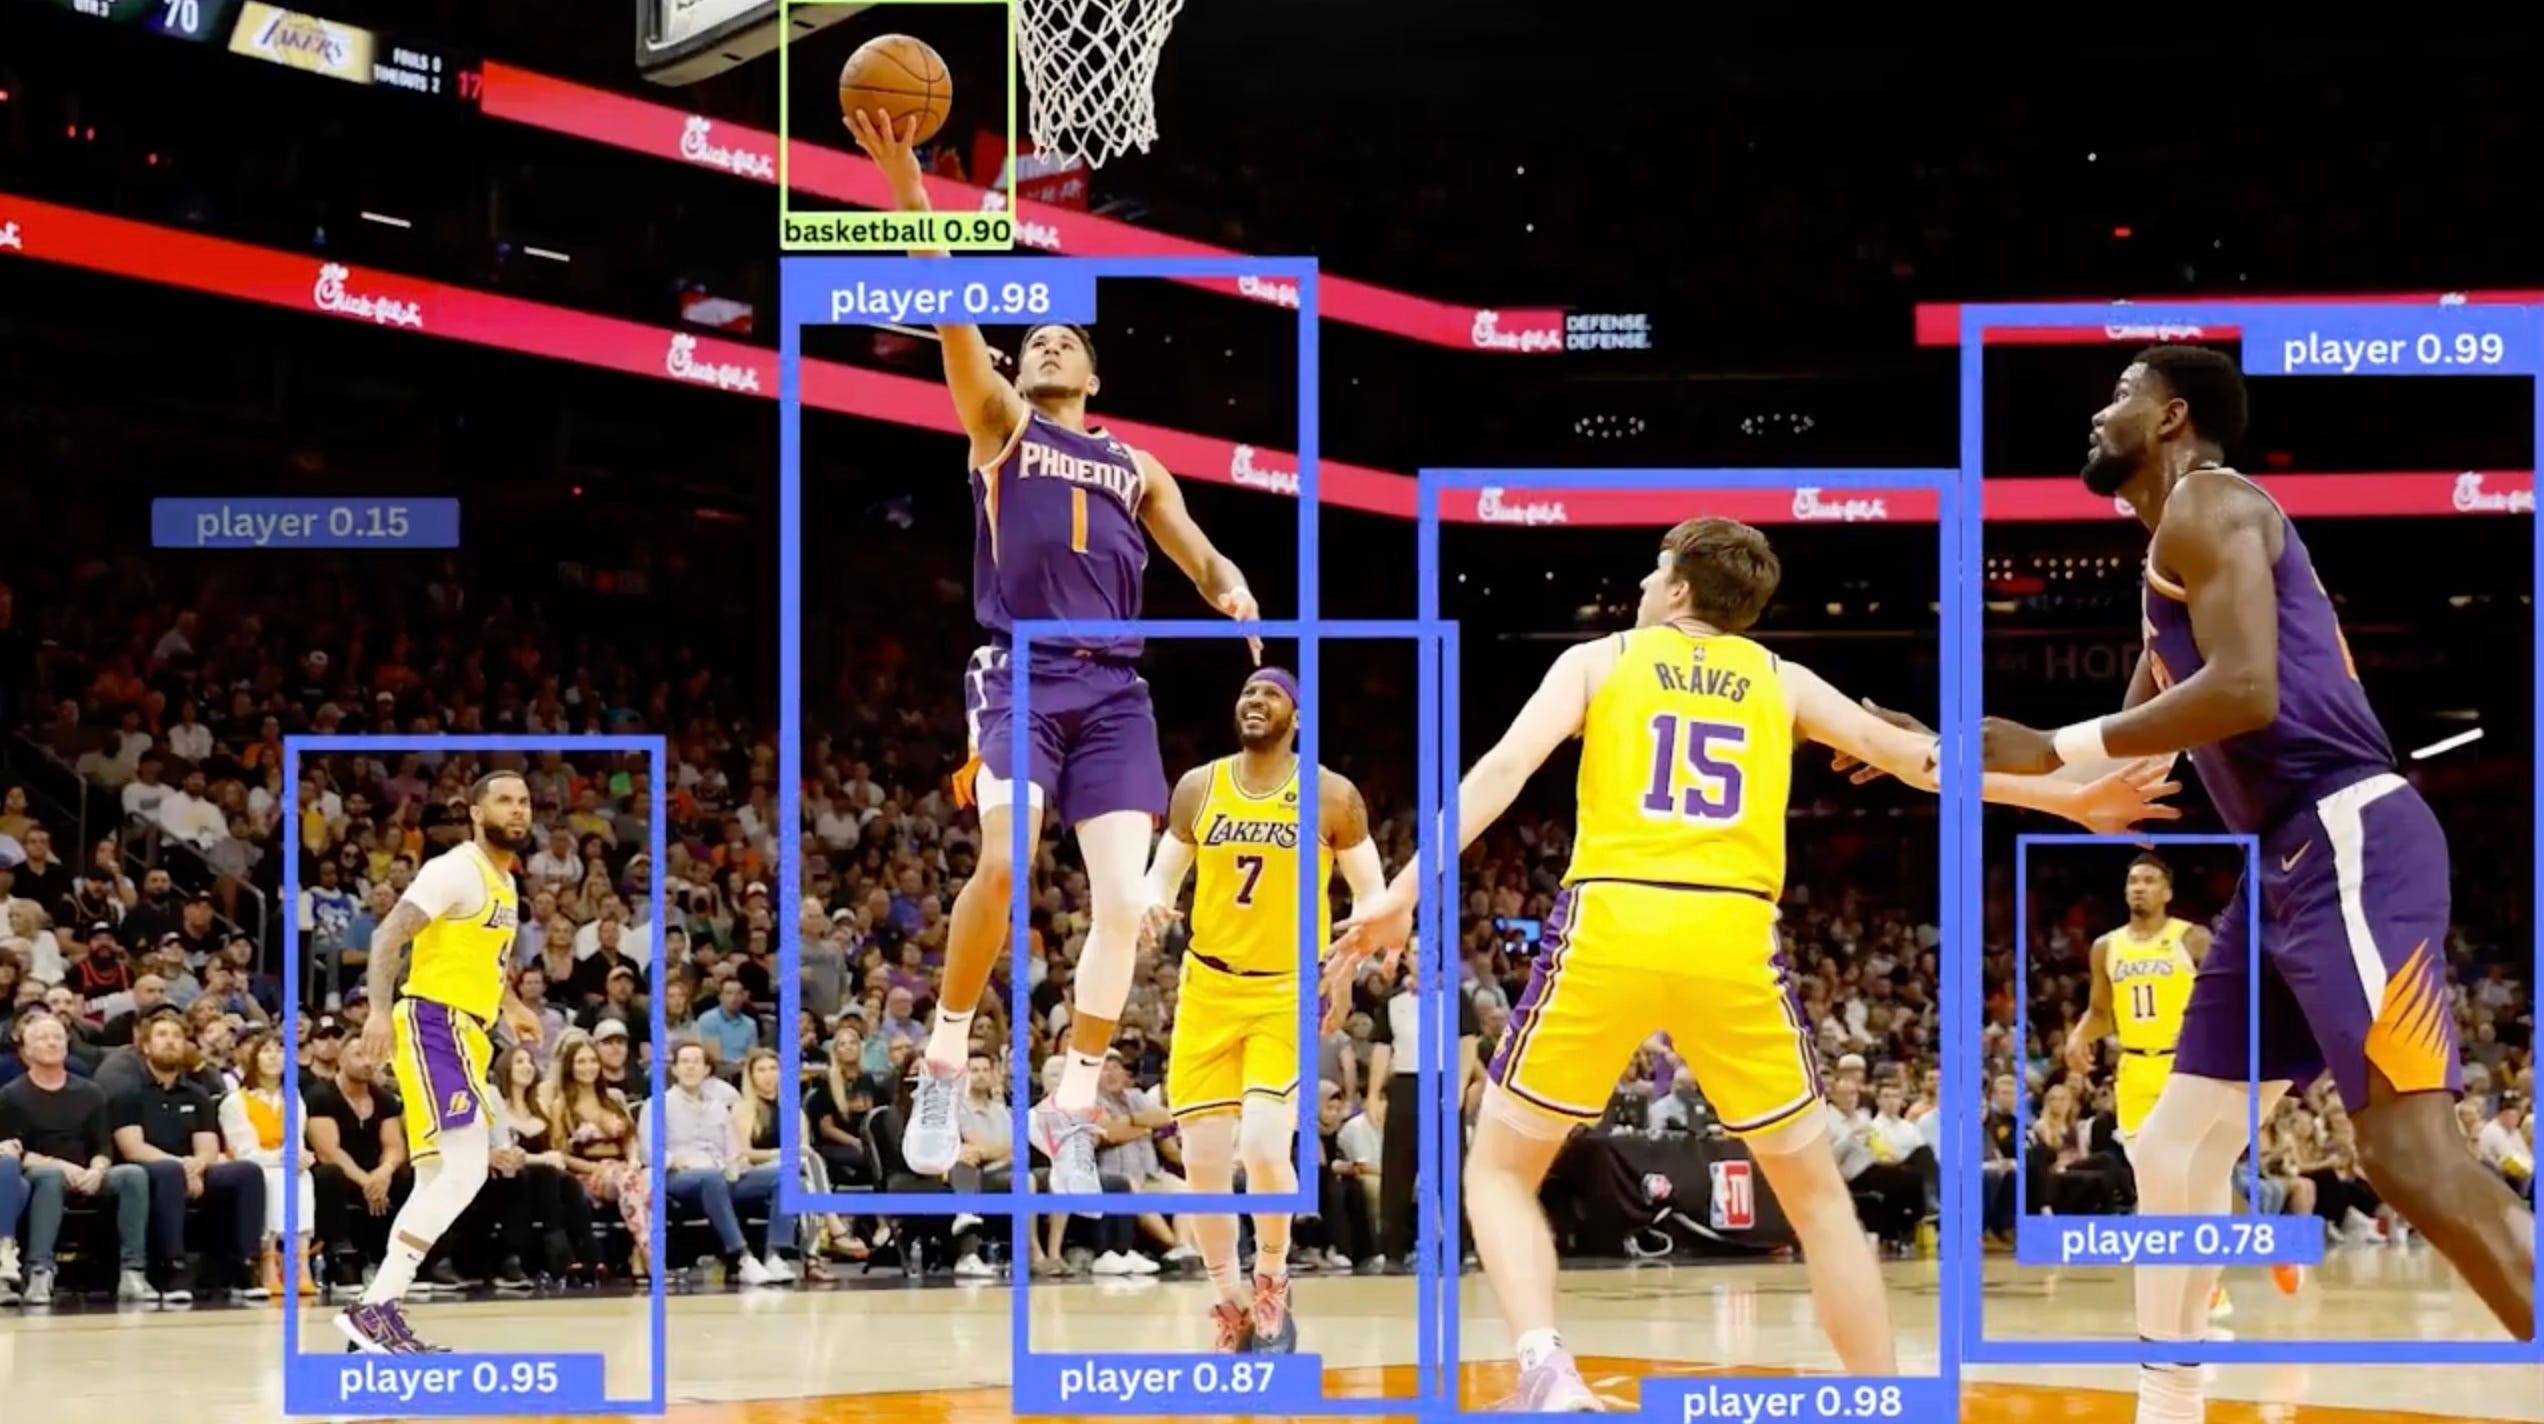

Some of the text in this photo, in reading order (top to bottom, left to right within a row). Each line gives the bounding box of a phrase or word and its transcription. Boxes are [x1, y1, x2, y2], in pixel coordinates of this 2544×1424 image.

[164, 0, 199, 34] 70
[262, 19, 343, 64] LAKERS
[393, 48, 429, 71] FOULS
[373, 63, 442, 93] TIMEOUTS 2
[1566, 314, 1651, 331] DEFENSE.
[1566, 333, 1651, 350] DEFENSE.
[1018, 440, 1138, 512] PHOENIX
[1070, 486, 1089, 554] 1
[1654, 662, 1751, 703] REAVES
[1644, 715, 1745, 820] 15
[1203, 813, 1300, 849] LAKERS
[1236, 855, 1263, 905] 7
[2114, 959, 2174, 984] LAKERS
[2133, 984, 2157, 1019] 11
